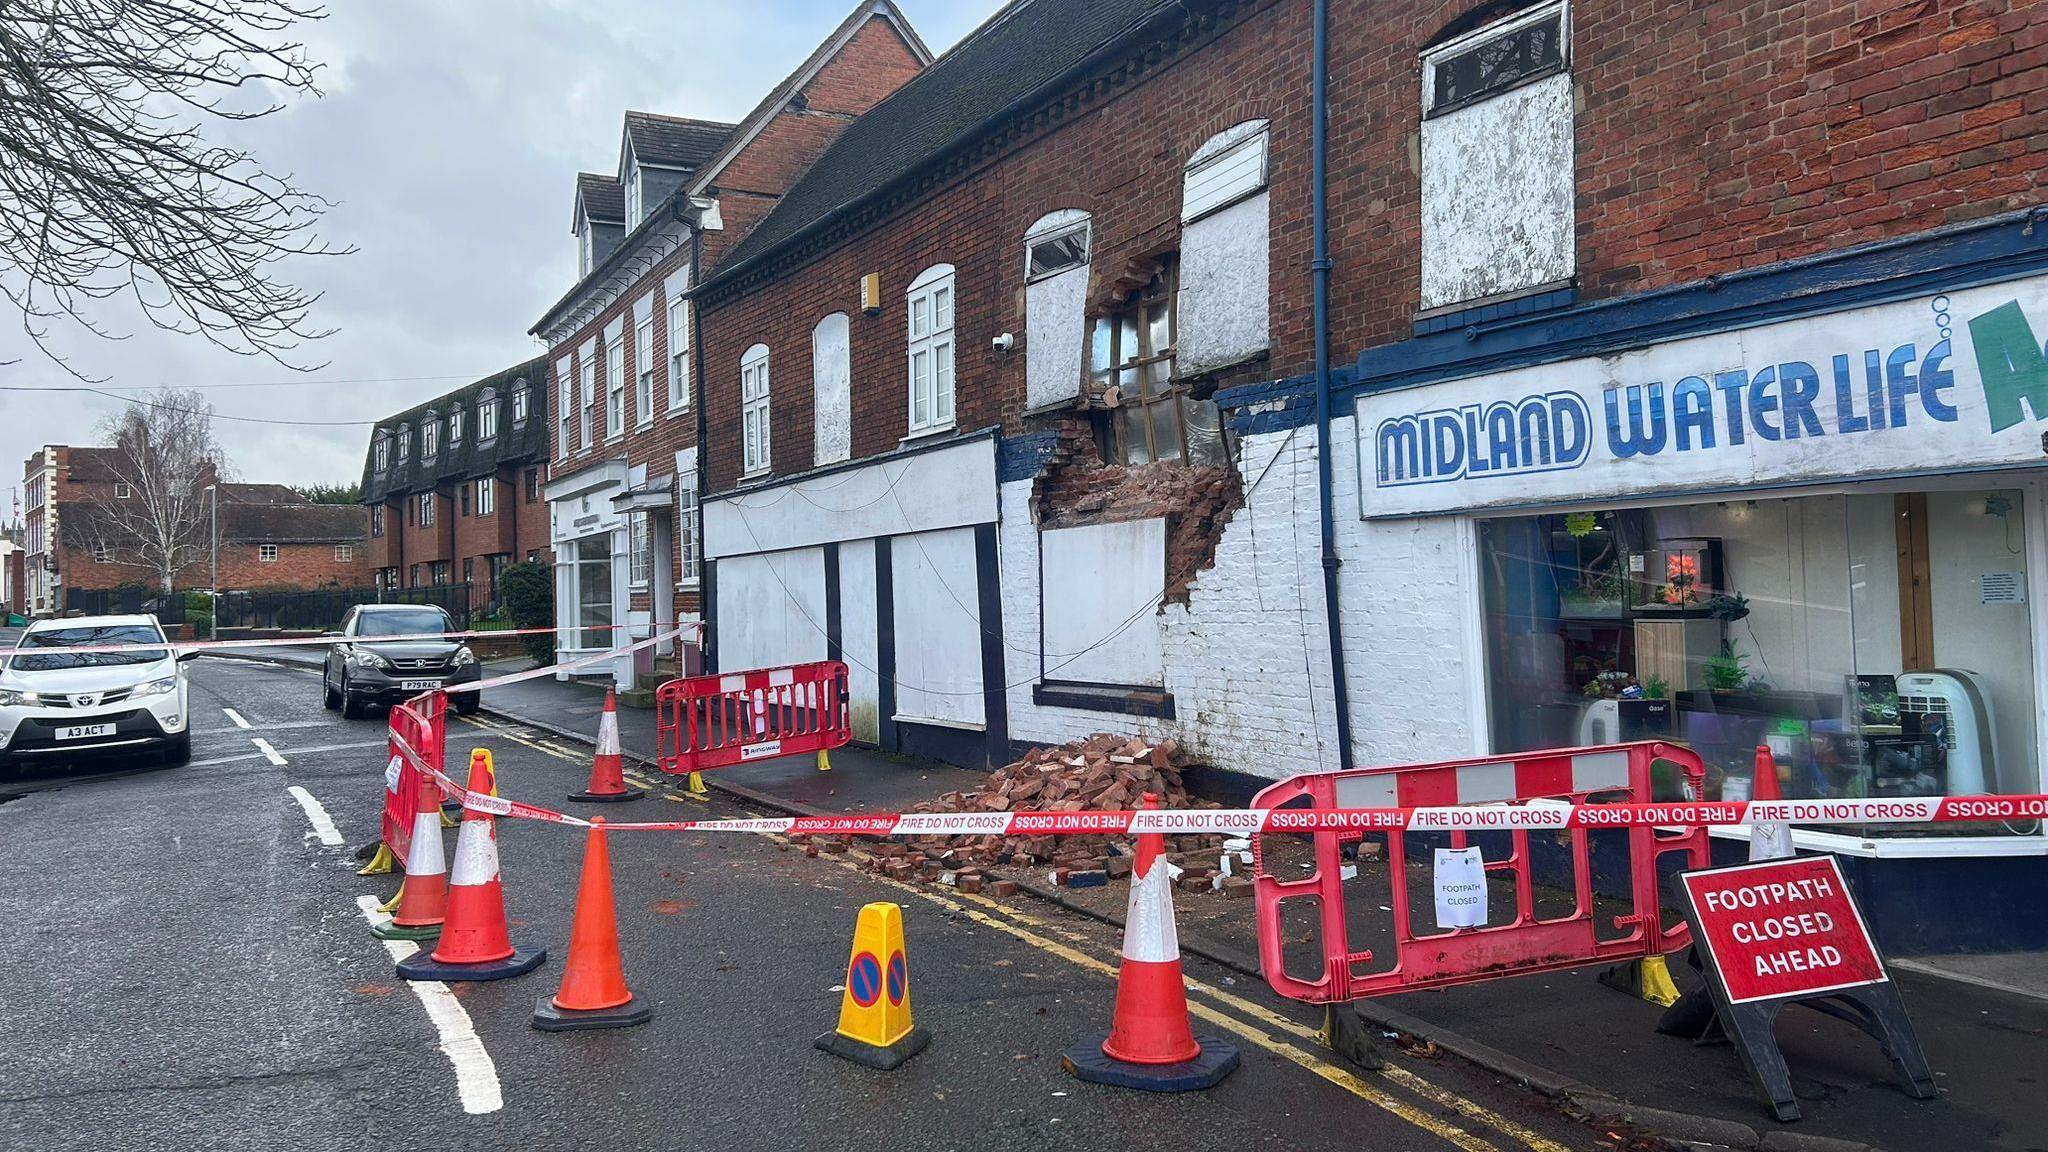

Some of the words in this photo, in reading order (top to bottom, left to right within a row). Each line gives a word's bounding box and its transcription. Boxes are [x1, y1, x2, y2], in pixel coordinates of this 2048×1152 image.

[1968, 298, 2048, 435] A
[1379, 397, 1587, 482] MIDLAND
[407, 681, 421, 689] P79
[67, 727, 81, 738] A3
[84, 725, 105, 736] ACT
[1577, 807, 1631, 824] CROSS
[1635, 807, 1668, 823] NOT
[1671, 807, 1696, 823] DO
[1700, 806, 1738, 822] FIRE
[1751, 805, 1791, 820] FIRE
[1794, 804, 1820, 820] DO
[1823, 803, 1861, 819] NOT
[1864, 803, 1929, 819] CROSS
[1947, 800, 2014, 817] CROSS
[901, 817, 924, 829] FIRE
[925, 817, 942, 829] DO
[944, 816, 967, 828] NOT
[969, 816, 1005, 828] CROSS
[1015, 815, 1053, 829] CROSS
[1055, 815, 1079, 829] NOT
[1081, 815, 1099, 828] DO
[1101, 814, 1127, 828] FIRE
[1136, 814, 1165, 828] FIRE
[1166, 814, 1184, 828] DO
[1186, 814, 1211, 828] NOT
[1217, 813, 1259, 828] CROSS
[1271, 812, 1317, 828] CROSS
[1319, 812, 1348, 827] NOT
[1349, 812, 1372, 827] DO
[1373, 812, 1405, 827] FIRE
[1416, 811, 1449, 826] FIRE
[1451, 811, 1473, 826] DO
[1476, 810, 1507, 825] NOT
[1510, 809, 1562, 825] CROSS
[1442, 884, 1480, 893] FOOTPATH
[1704, 877, 1834, 913] FOOTPATH
[1447, 896, 1479, 906] CLOSED
[1731, 911, 1835, 944] CLOSED
[1754, 945, 1842, 977] AHEAD
